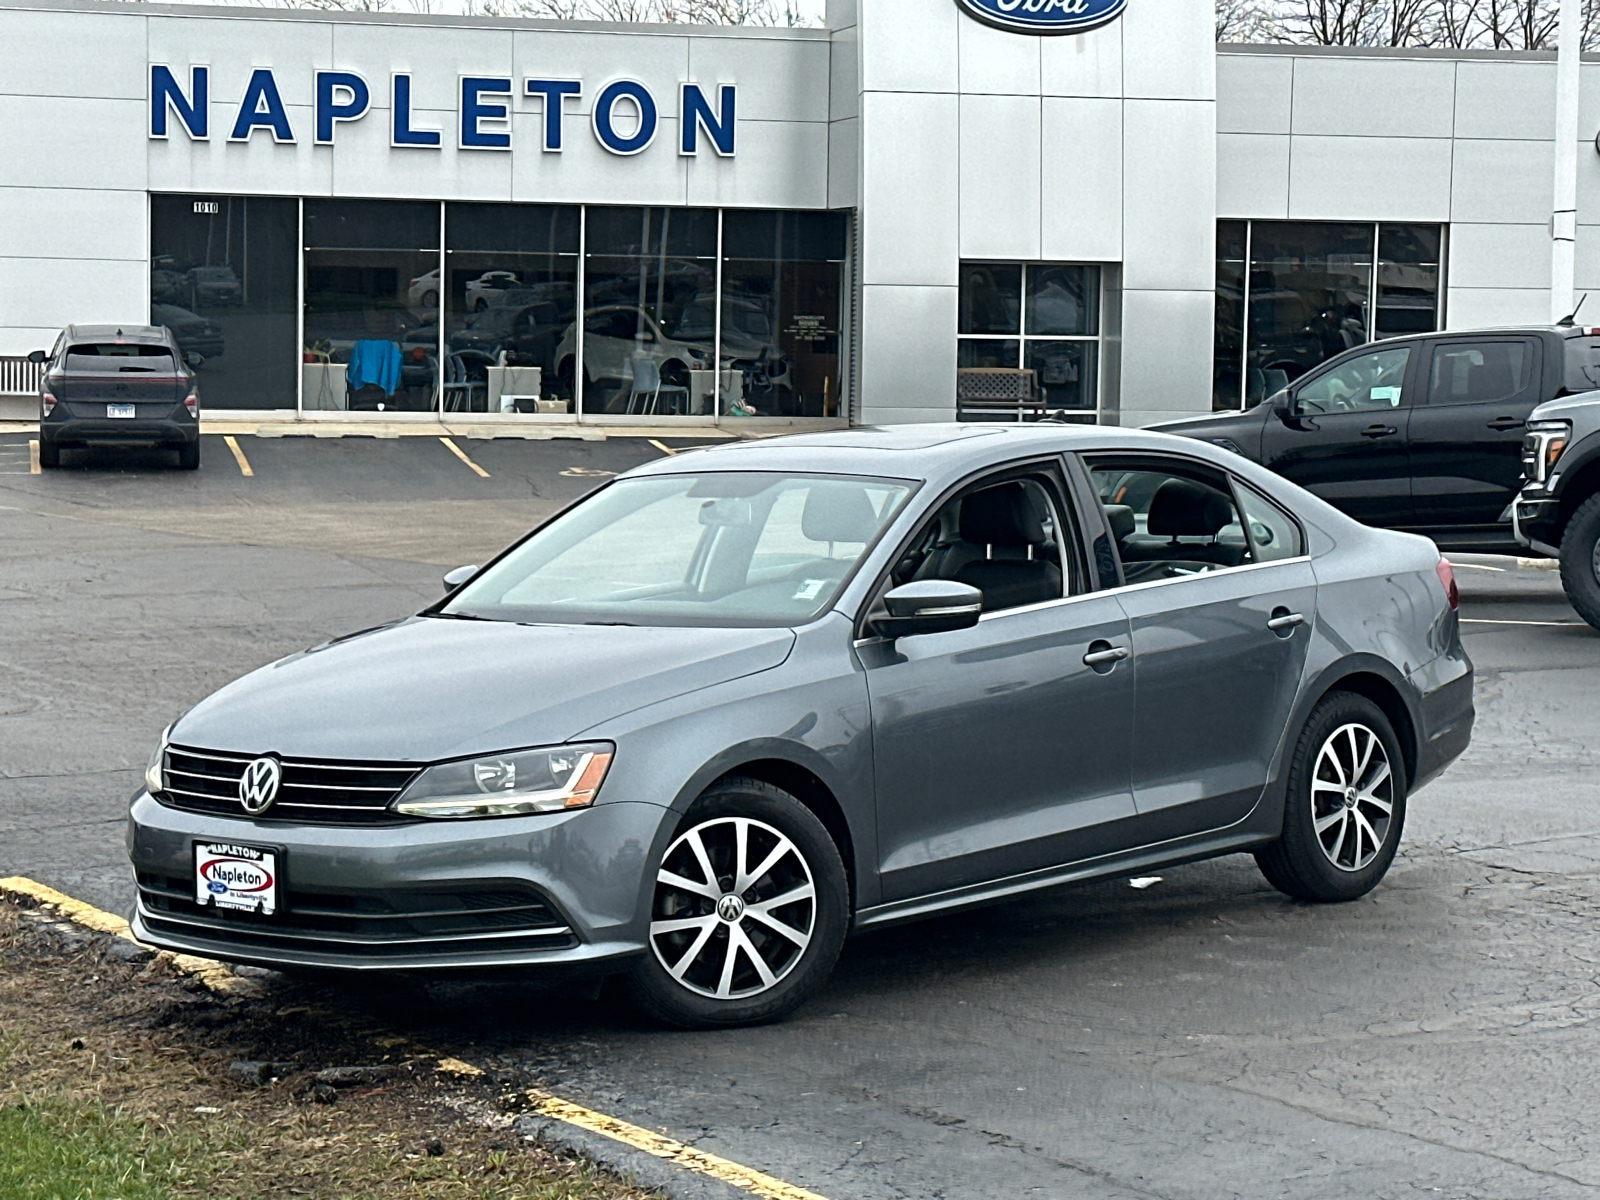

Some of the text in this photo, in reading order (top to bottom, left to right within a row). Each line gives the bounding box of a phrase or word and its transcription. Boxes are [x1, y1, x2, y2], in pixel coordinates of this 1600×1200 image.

[148, 63, 736, 157] NAPLETON
[196, 202, 217, 212] 1010
[211, 844, 257, 859] NAPLETON
[213, 864, 261, 885] Napleton
